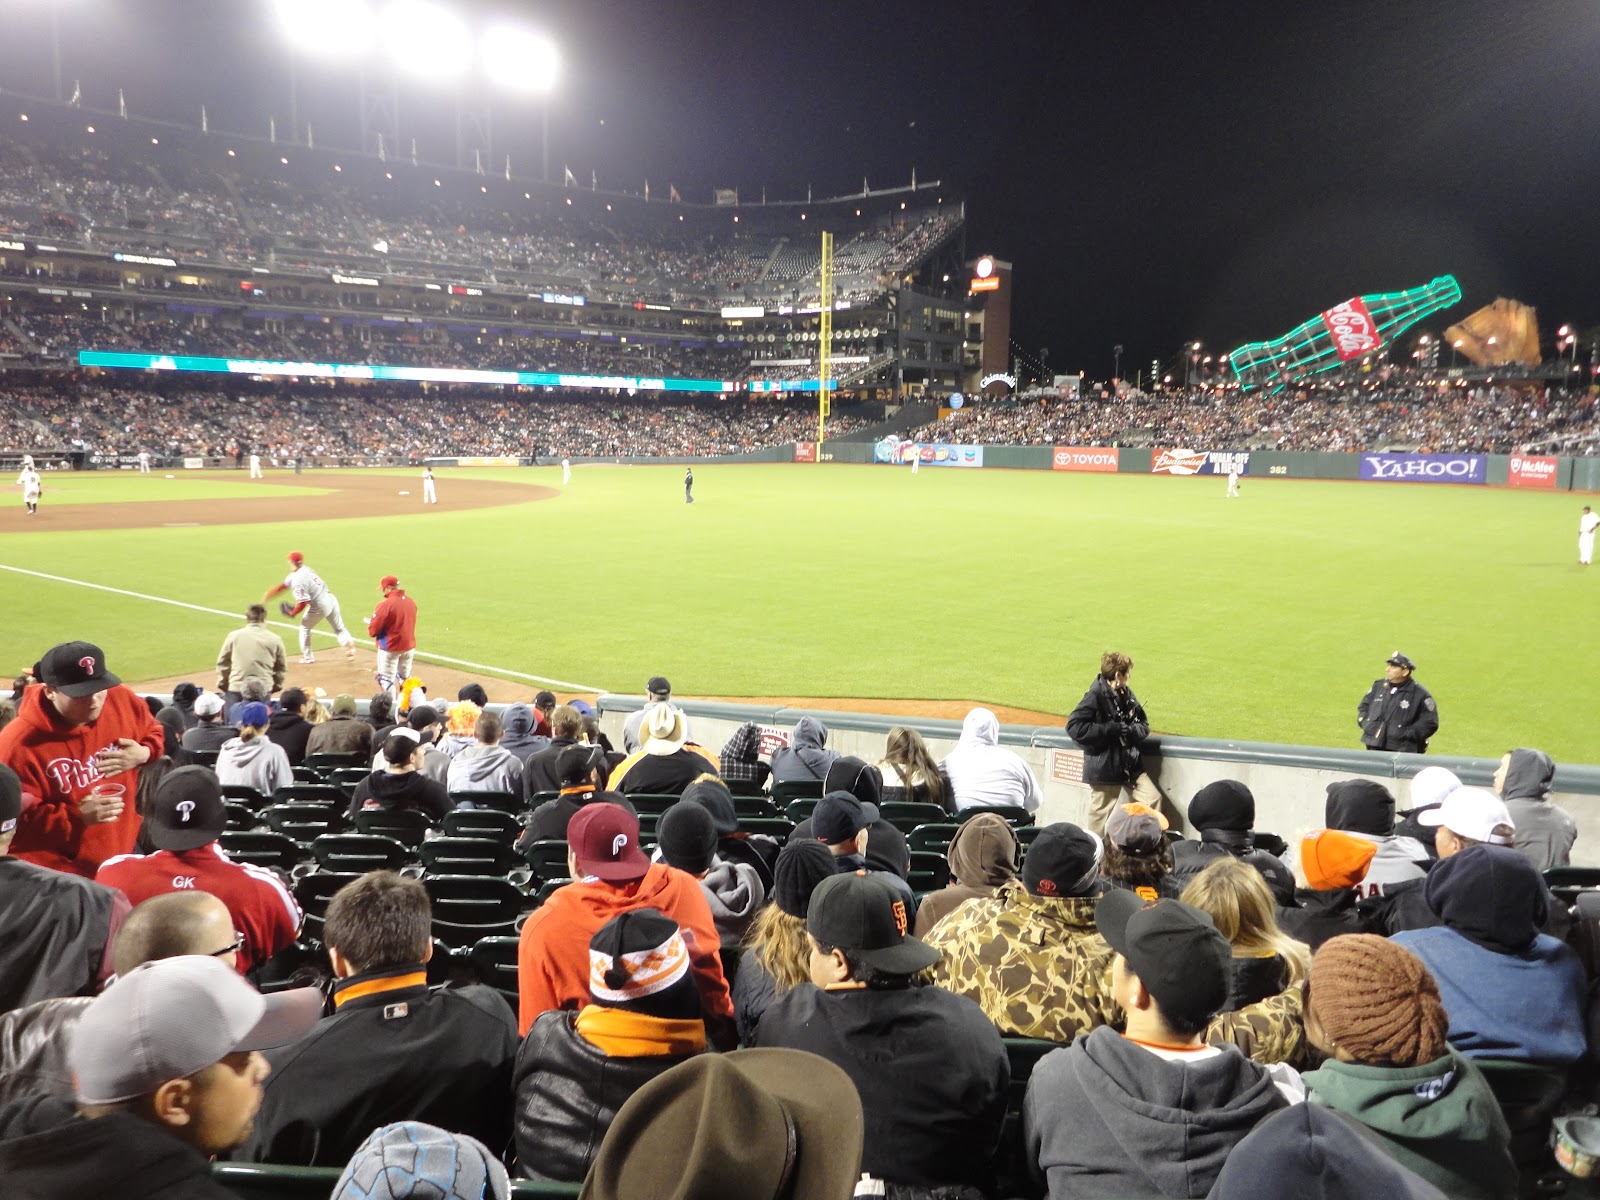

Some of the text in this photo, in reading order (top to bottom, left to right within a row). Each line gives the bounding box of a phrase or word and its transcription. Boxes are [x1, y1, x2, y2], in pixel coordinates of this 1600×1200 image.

[1072, 453, 1116, 465] TOYOTA
[1154, 455, 1206, 467] Budweiser
[1365, 457, 1478, 478] YAHOO!
[1521, 460, 1555, 473] McAfee
[176, 801, 195, 822] P
[612, 833, 627, 856] P
[172, 876, 196, 888] GK
